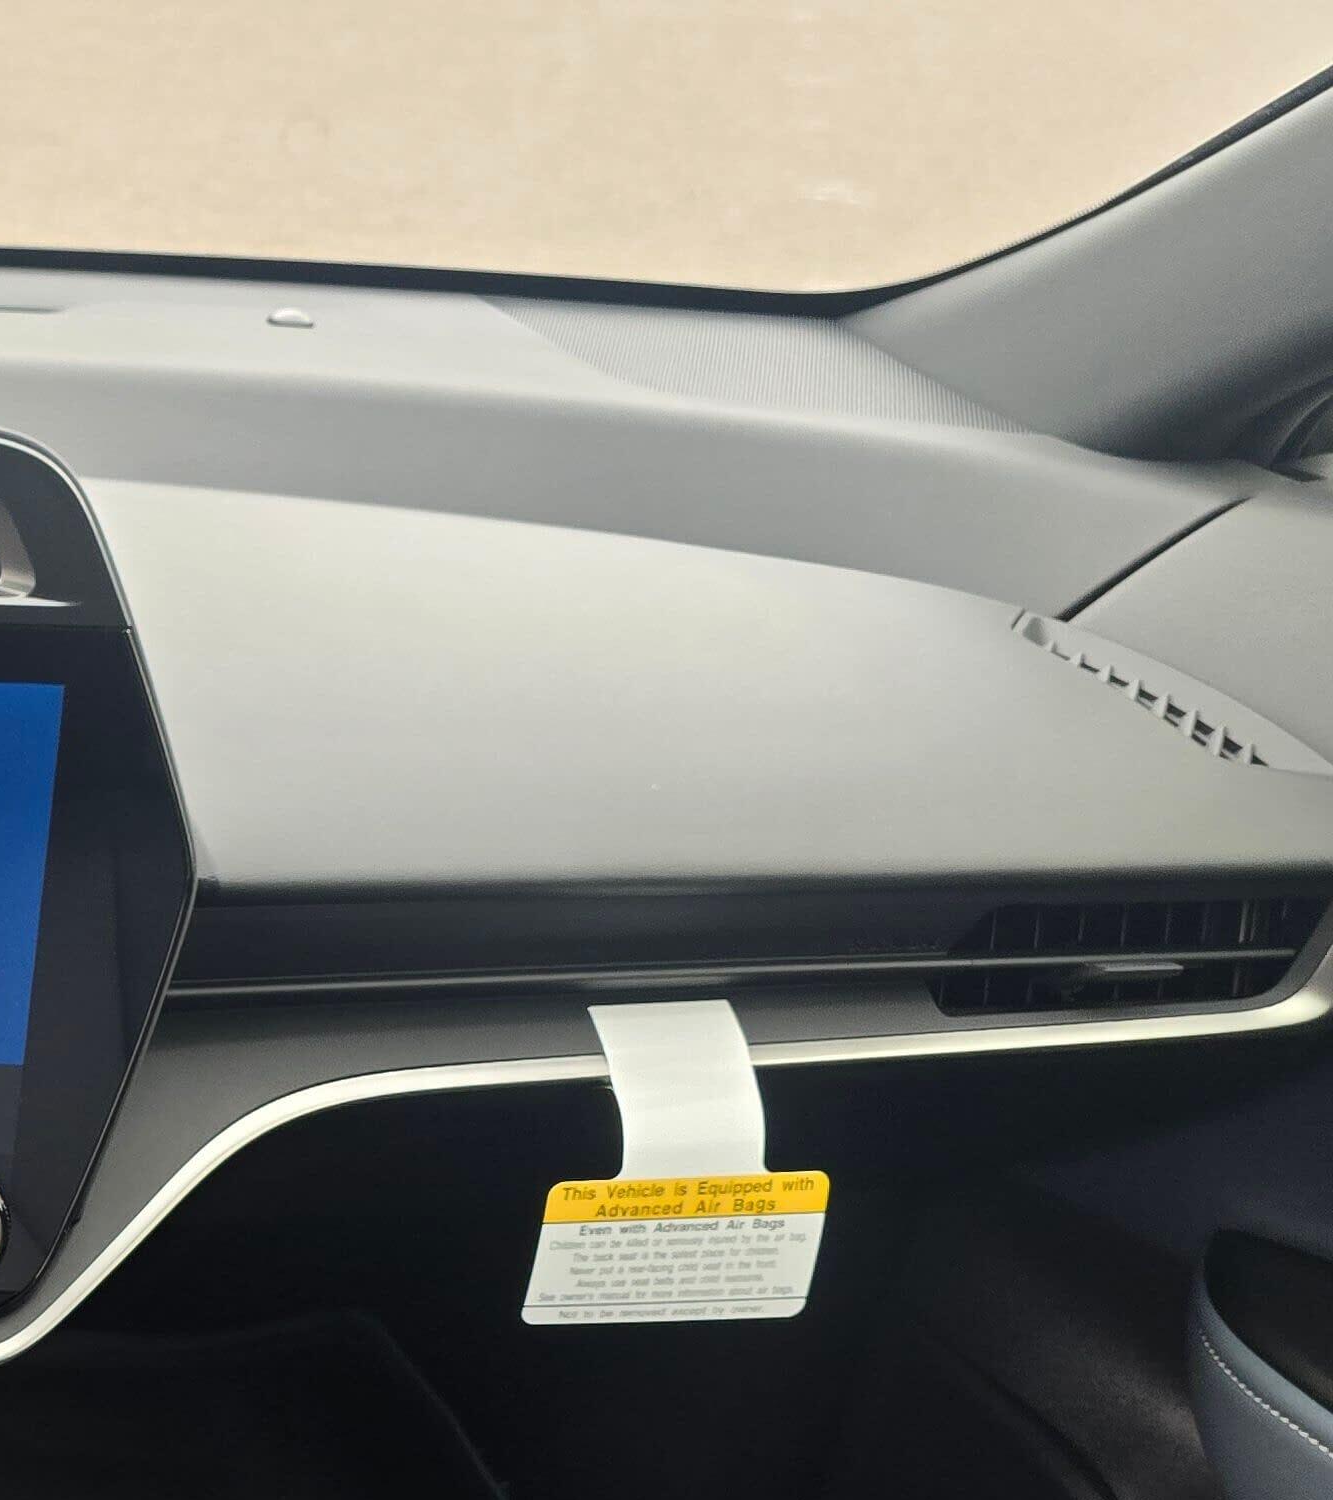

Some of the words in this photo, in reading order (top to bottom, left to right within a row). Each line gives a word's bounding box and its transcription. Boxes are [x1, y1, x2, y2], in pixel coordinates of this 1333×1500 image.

[563, 1186, 597, 1201] This
[607, 1183, 665, 1199] Vehicle
[698, 1179, 774, 1198] Equipped
[782, 1177, 815, 1191] with
[595, 1202, 683, 1218] Advanced
[696, 1199, 721, 1213] Air
[733, 1198, 776, 1213] Bags
[579, 1224, 613, 1236] Even
[619, 1223, 647, 1234] with
[653, 1221, 719, 1233] Advanced
[726, 1219, 745, 1230] Air
[753, 1218, 785, 1230] Bags
